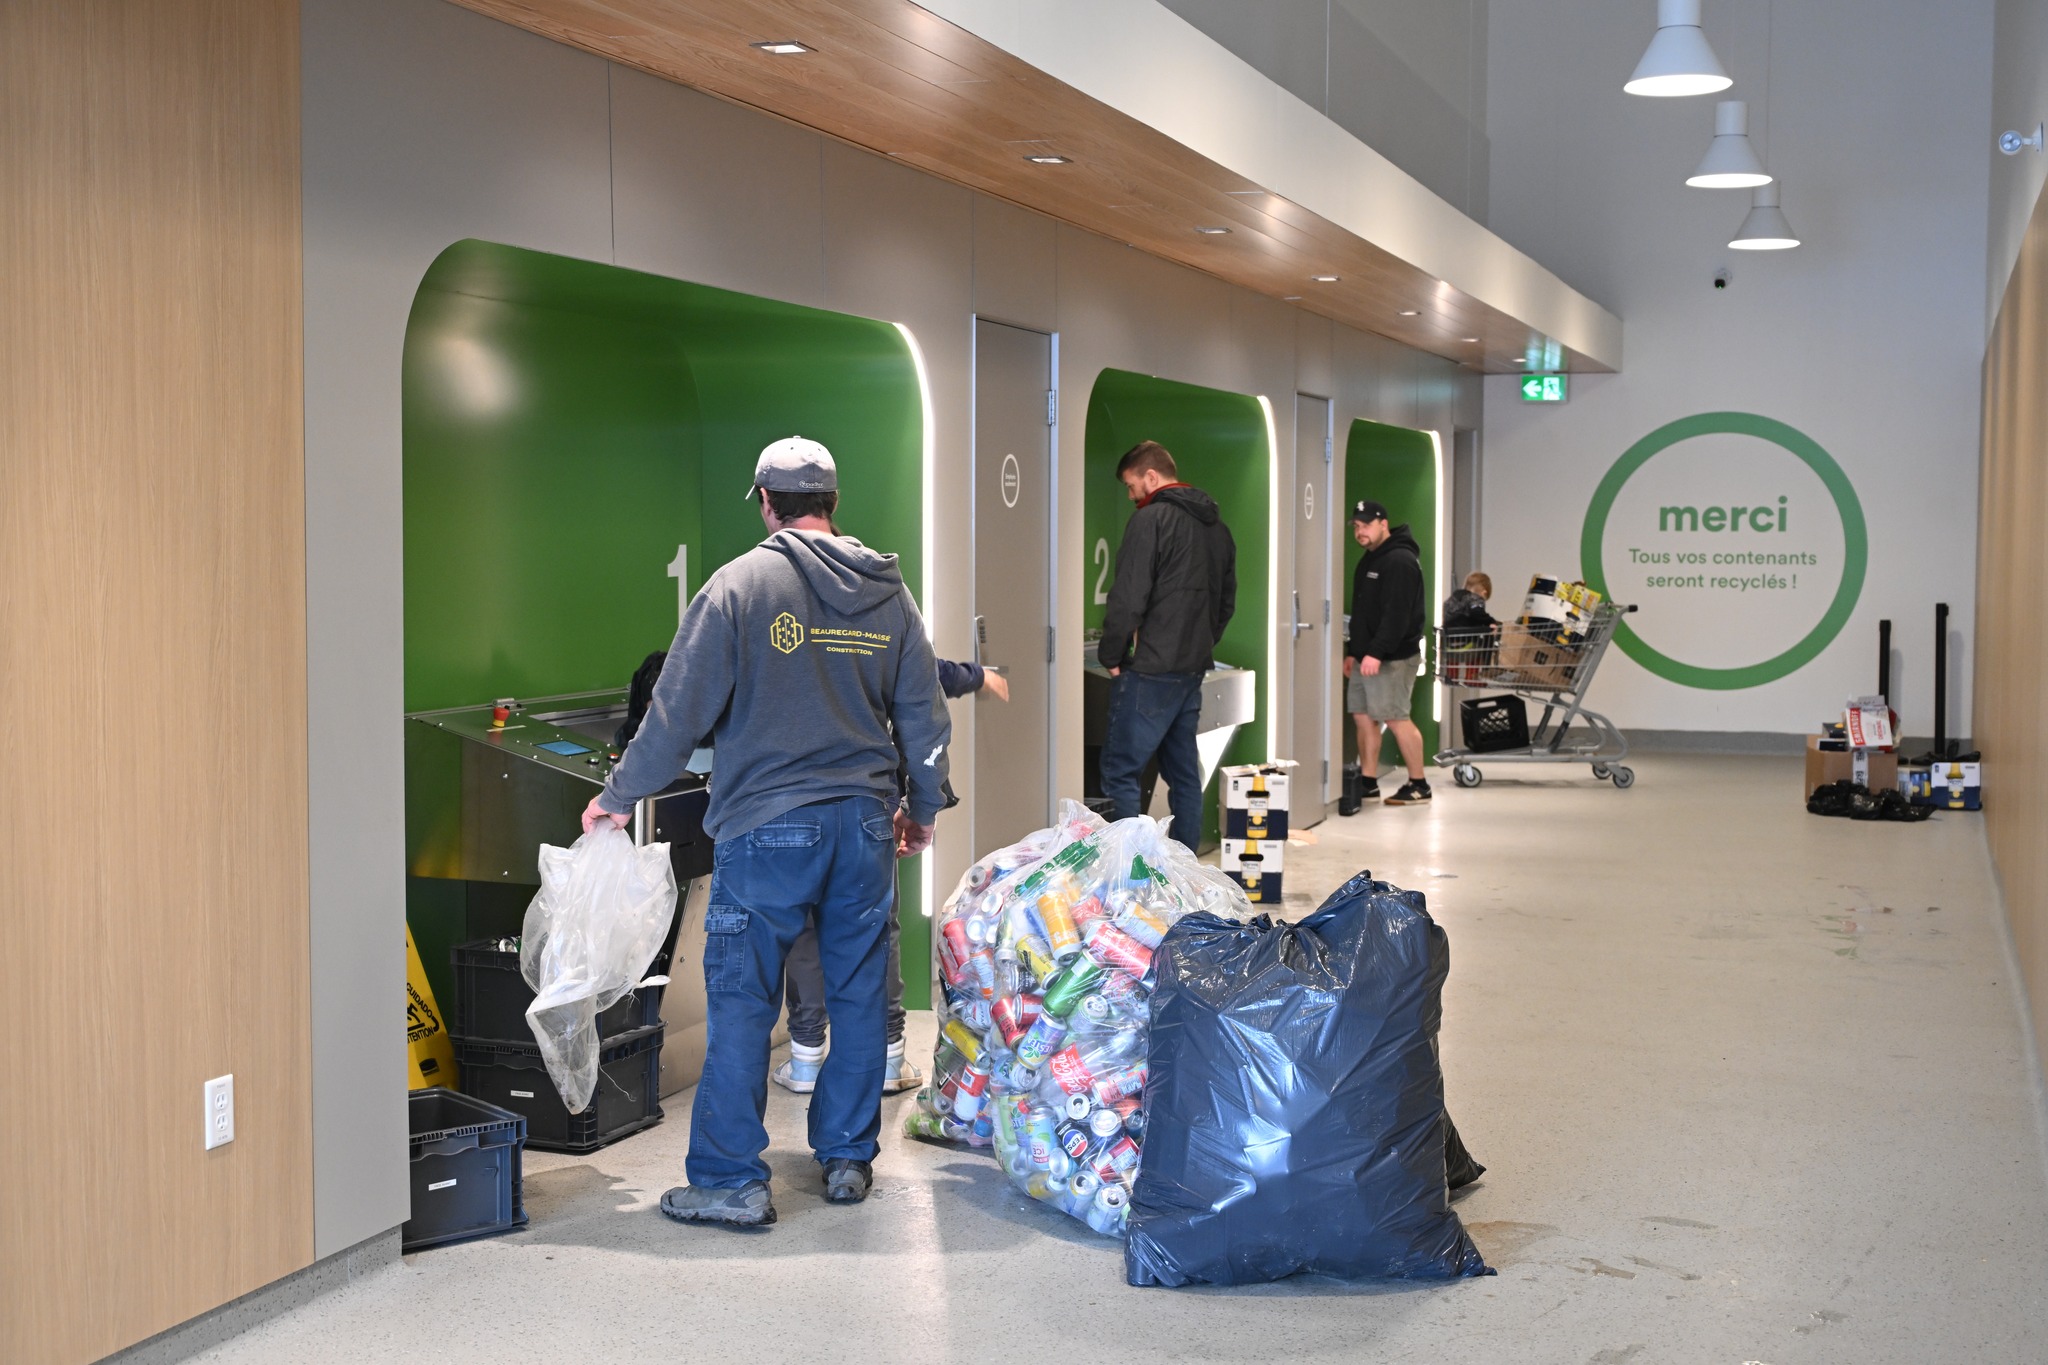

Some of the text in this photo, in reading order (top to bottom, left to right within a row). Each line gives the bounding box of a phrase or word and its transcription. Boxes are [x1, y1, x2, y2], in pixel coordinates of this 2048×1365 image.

[1659, 495, 1788, 532] merci
[1094, 537, 1109, 605] 2
[1629, 548, 1817, 566] Tous vos contenants
[667, 544, 687, 628] 1
[1647, 575, 1704, 588] seront
[1710, 573, 1787, 592] recyclés
[407, 982, 433, 1018] CUIDADO
